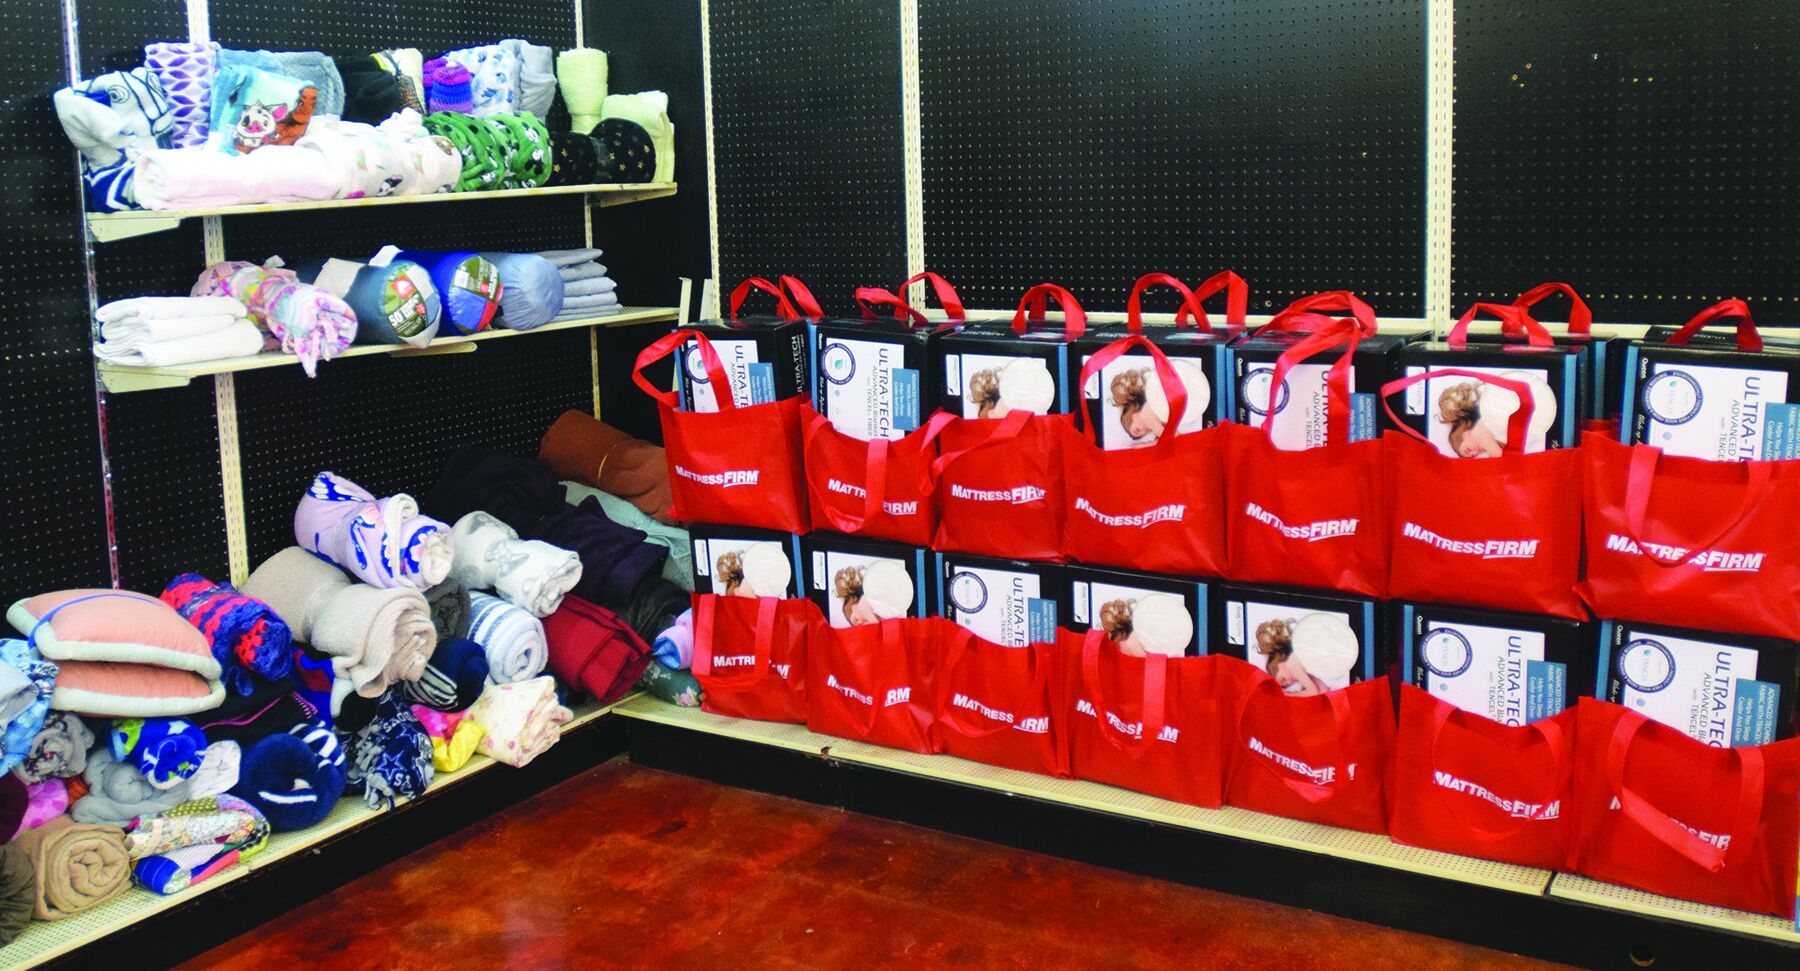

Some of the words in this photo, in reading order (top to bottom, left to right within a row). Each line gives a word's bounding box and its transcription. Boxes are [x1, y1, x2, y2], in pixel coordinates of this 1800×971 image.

[735, 345, 749, 408] ULTRA-TE
[1641, 357, 1649, 379] Queen
[879, 348, 889, 438] ULTRA-TECH
[1728, 399, 1740, 456] ADVANCED
[1739, 376, 1761, 462] ULTRA-TE
[1718, 433, 1727, 460] TENCE
[675, 465, 759, 488] MATTRESSFIRM
[828, 479, 917, 516] MATTRFIRM
[1075, 497, 1185, 529] MATTRESSFIRM
[1247, 502, 1358, 542] MATTRESSFIRM
[1404, 522, 1539, 560] MATTRESSFIRM
[1606, 533, 1763, 572] MATRESFIRM
[1013, 577, 1024, 647] ULTRA-TE
[1616, 625, 1624, 645] Queen
[1497, 656, 1505, 706] ADVANCED
[1507, 636, 1521, 727] ULTRA-TEC
[1700, 673, 1712, 729] ADVANCED
[1709, 651, 1731, 748] ULTRA-TEC
[953, 693, 1048, 733] MATTRESSIRM
[1766, 687, 1775, 720] ADVANCED
[1764, 720, 1772, 744] TECHNO
